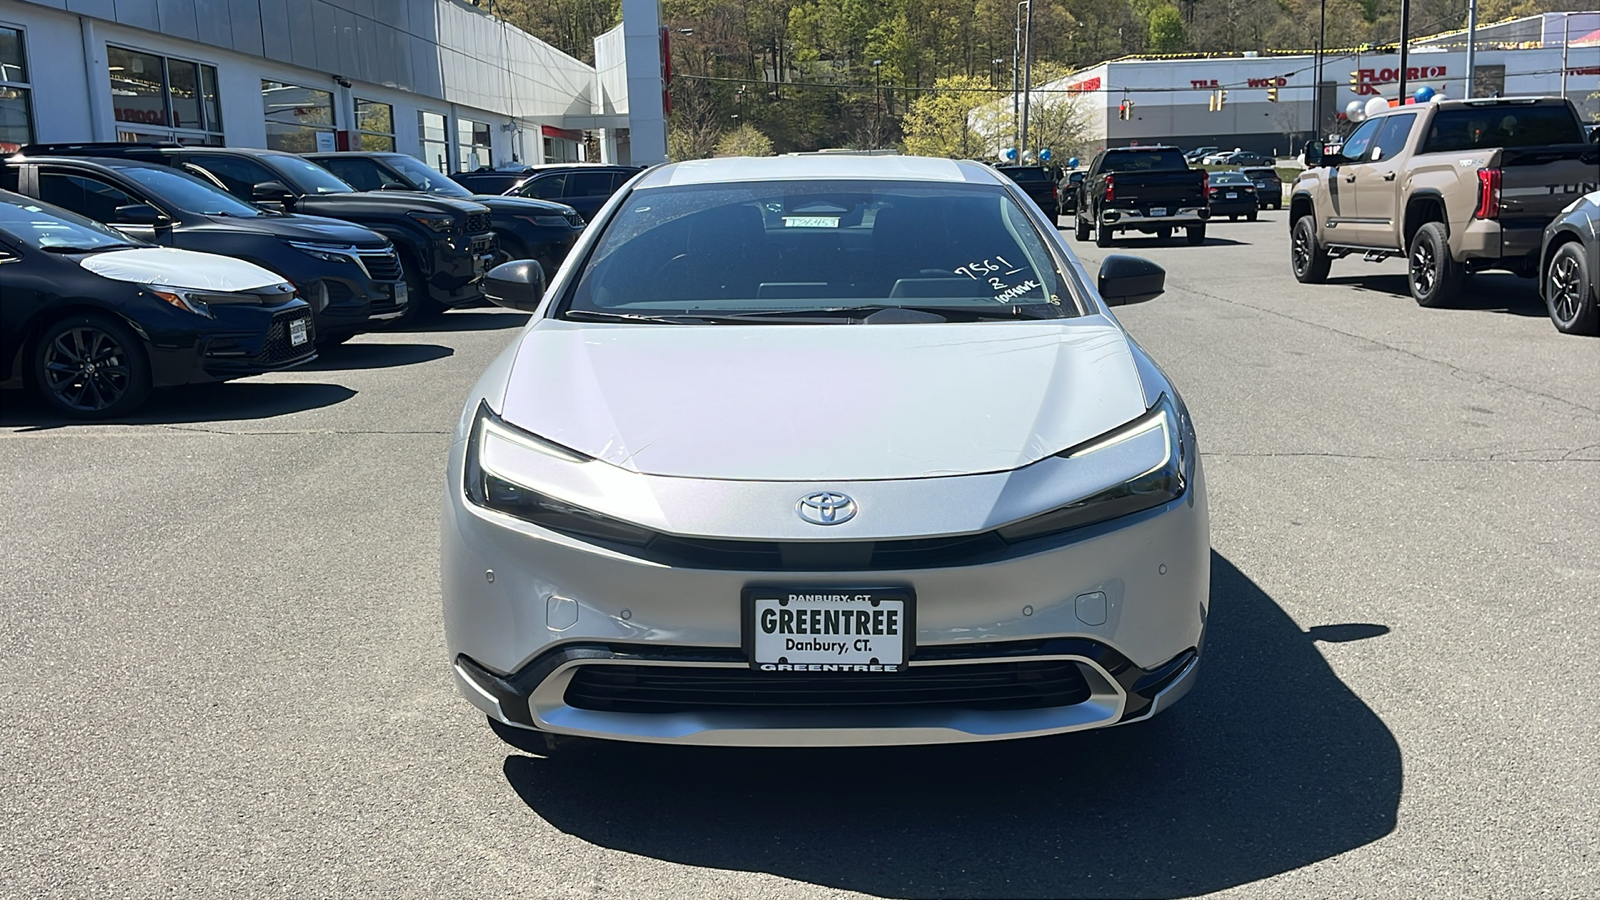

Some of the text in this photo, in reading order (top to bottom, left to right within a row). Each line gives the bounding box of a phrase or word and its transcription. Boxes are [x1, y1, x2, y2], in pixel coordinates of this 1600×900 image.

[1190, 80, 1218, 90] TILE
[1247, 78, 1287, 88] WOD
[788, 594, 850, 602] DANBURY,
[761, 608, 898, 635] GREENTREE
[786, 638, 873, 655] Danbury, CT.
[760, 664, 898, 672] GREENTREE
